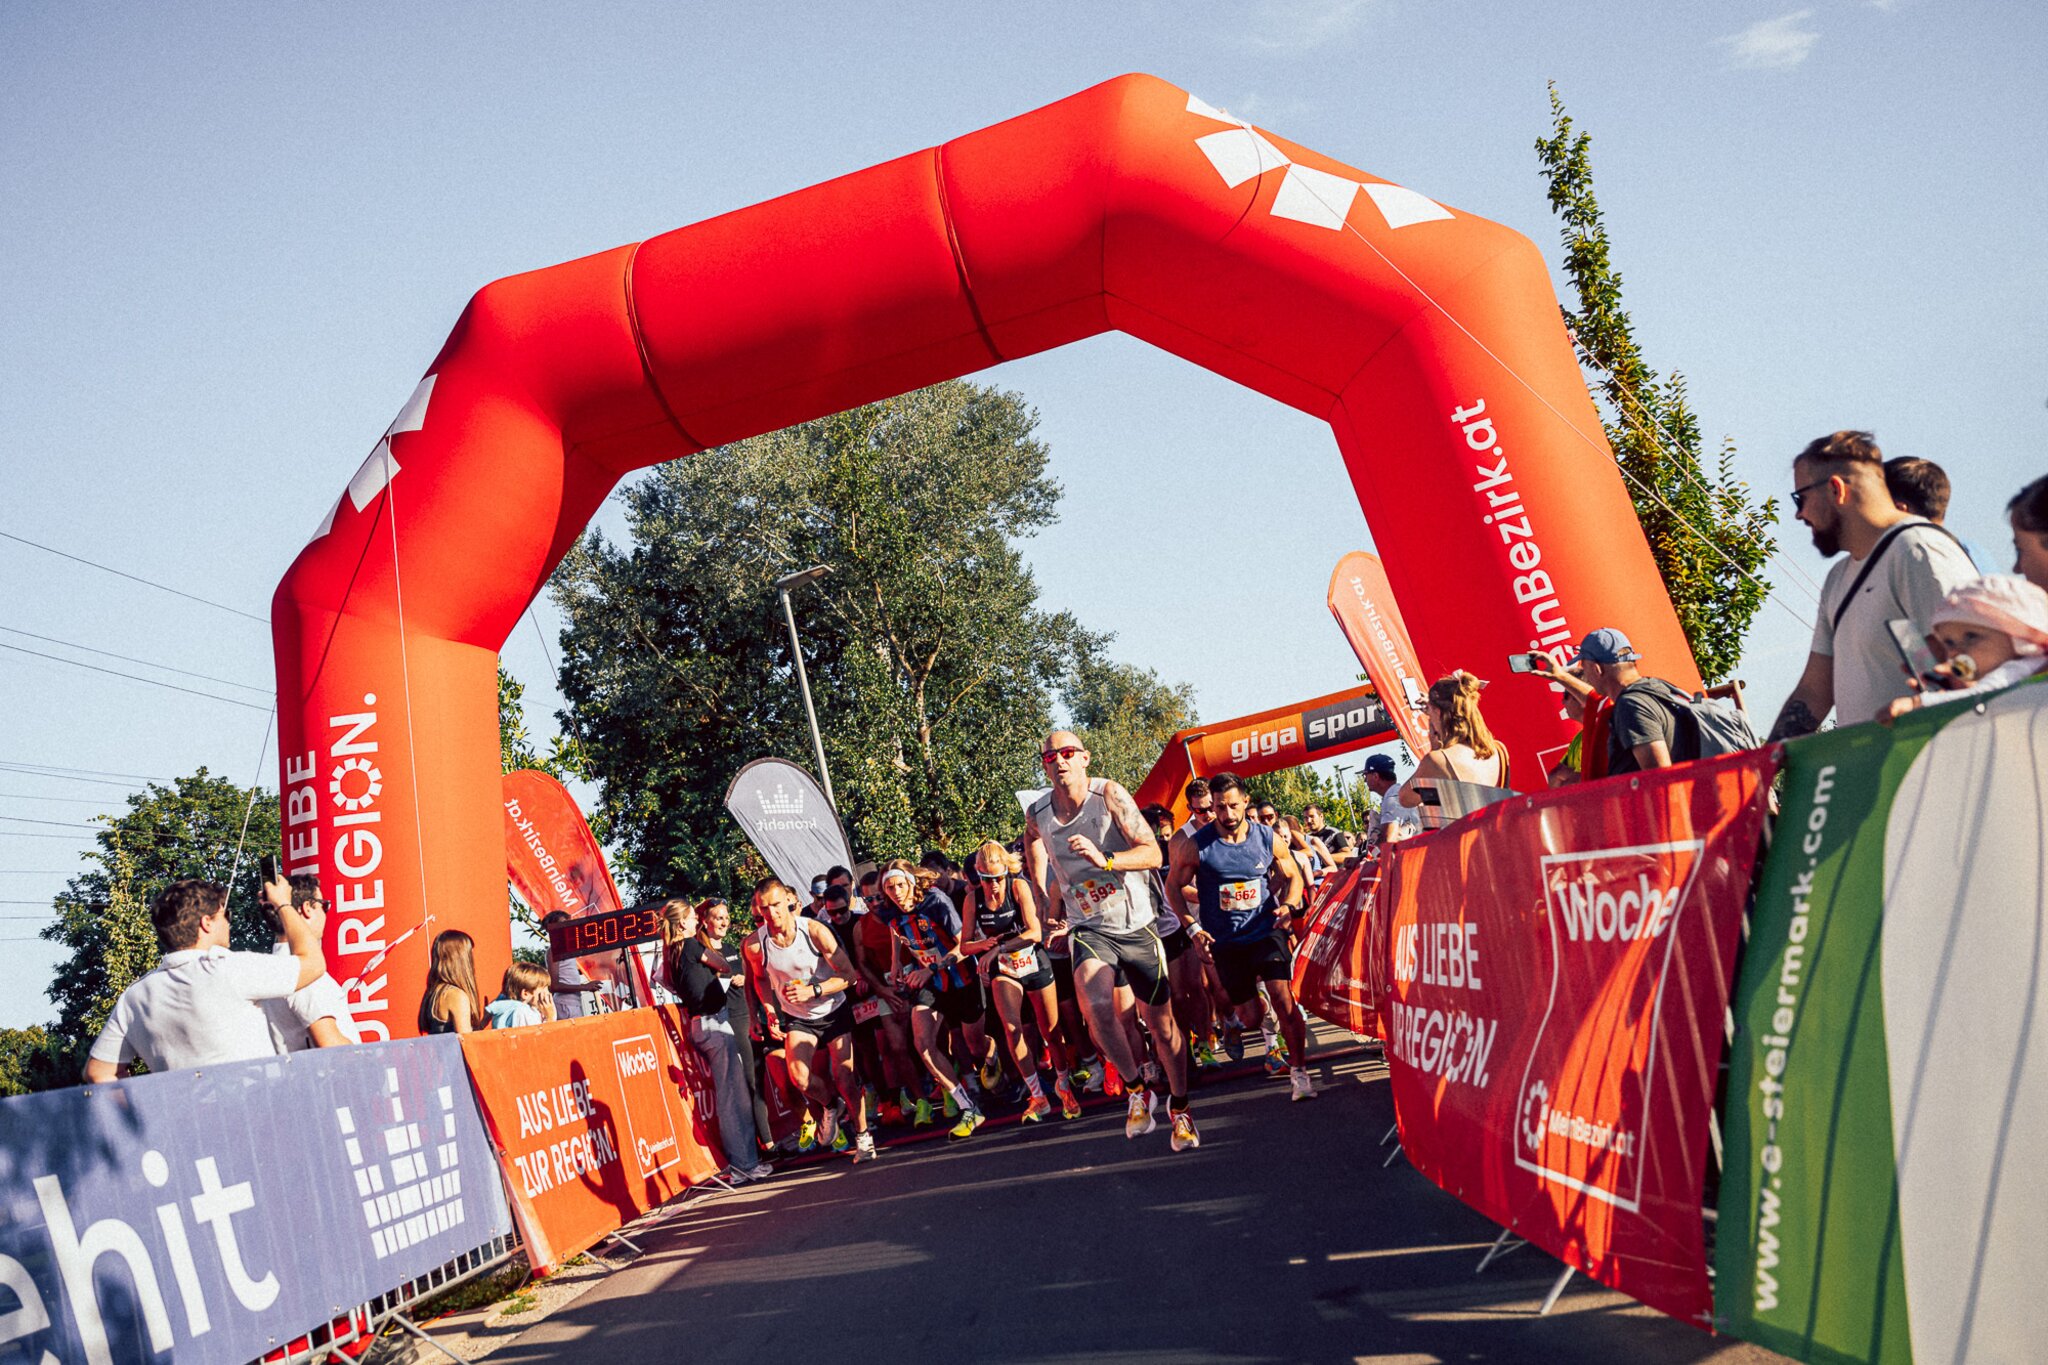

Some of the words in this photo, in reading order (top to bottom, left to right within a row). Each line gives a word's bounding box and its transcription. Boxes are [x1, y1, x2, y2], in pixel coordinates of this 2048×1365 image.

[1451, 398, 1582, 720] einBezirk.at
[1231, 727, 1298, 764] giga
[1308, 702, 1384, 739] spor
[286, 750, 319, 877] IEBE
[1089, 882, 1117, 903] 593
[1235, 888, 1257, 901] 562
[1556, 873, 1680, 942] Woche
[575, 909, 658, 949] 19:02:3
[1394, 923, 1418, 983] AUS
[1422, 922, 1482, 990] LIEBE
[1011, 955, 1032, 969] 554
[342, 973, 391, 1043] UR
[1754, 765, 1836, 1311] www.e-steiermark.com
[618, 1046, 657, 1079] Woche
[515, 1088, 552, 1139] AUS
[550, 1078, 596, 1126] LIEBE
[1548, 1109, 1635, 1158] MeinBezirk.at
[514, 1148, 553, 1199] ZUR
